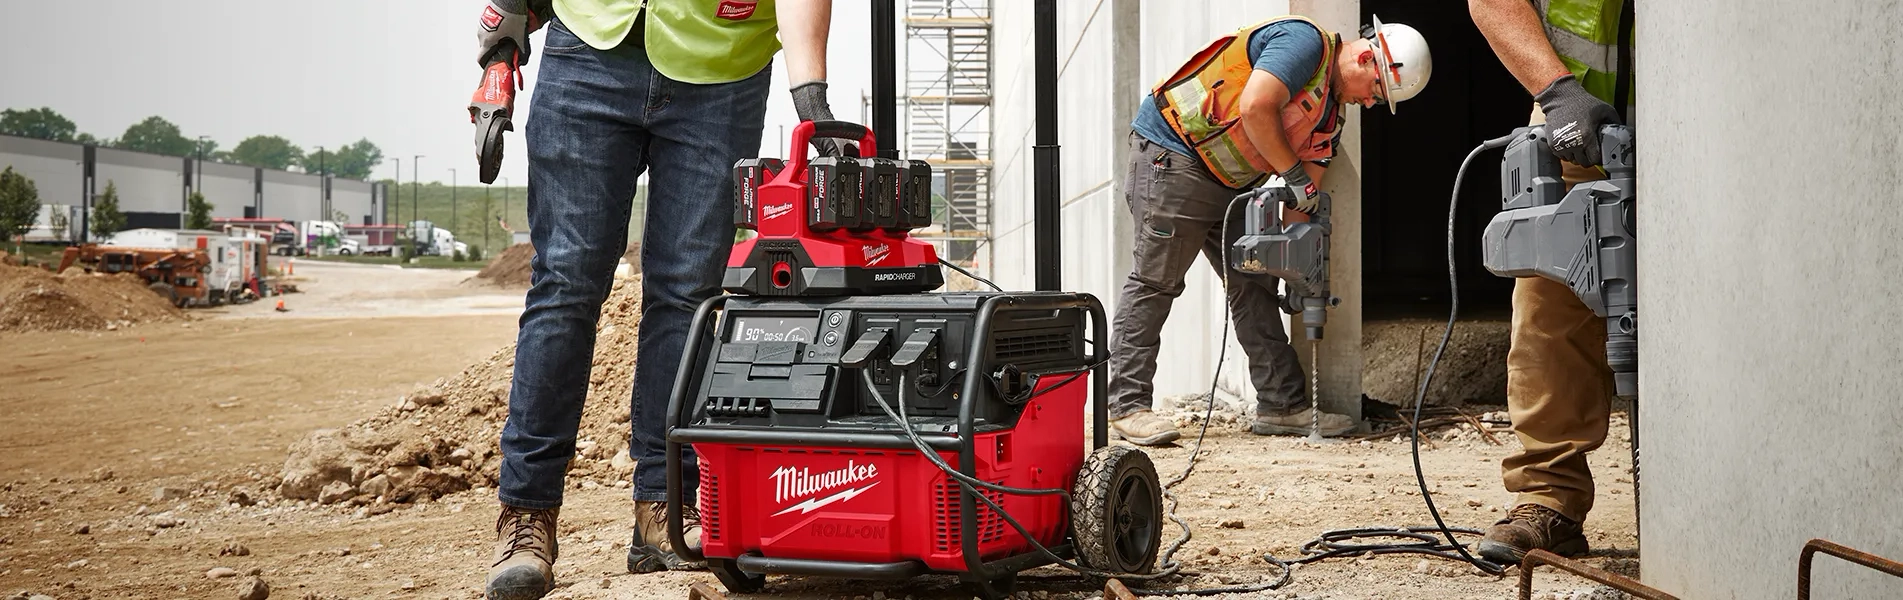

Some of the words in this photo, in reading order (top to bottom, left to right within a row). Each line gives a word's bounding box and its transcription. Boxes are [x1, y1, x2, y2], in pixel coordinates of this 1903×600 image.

[722, 4, 754, 14] Milwaukee
[762, 202, 793, 217] Milwaukee
[861, 242, 890, 261] Milwaukee
[768, 459, 879, 504] Milwaukee
[811, 523, 886, 540] ROLL-ON
